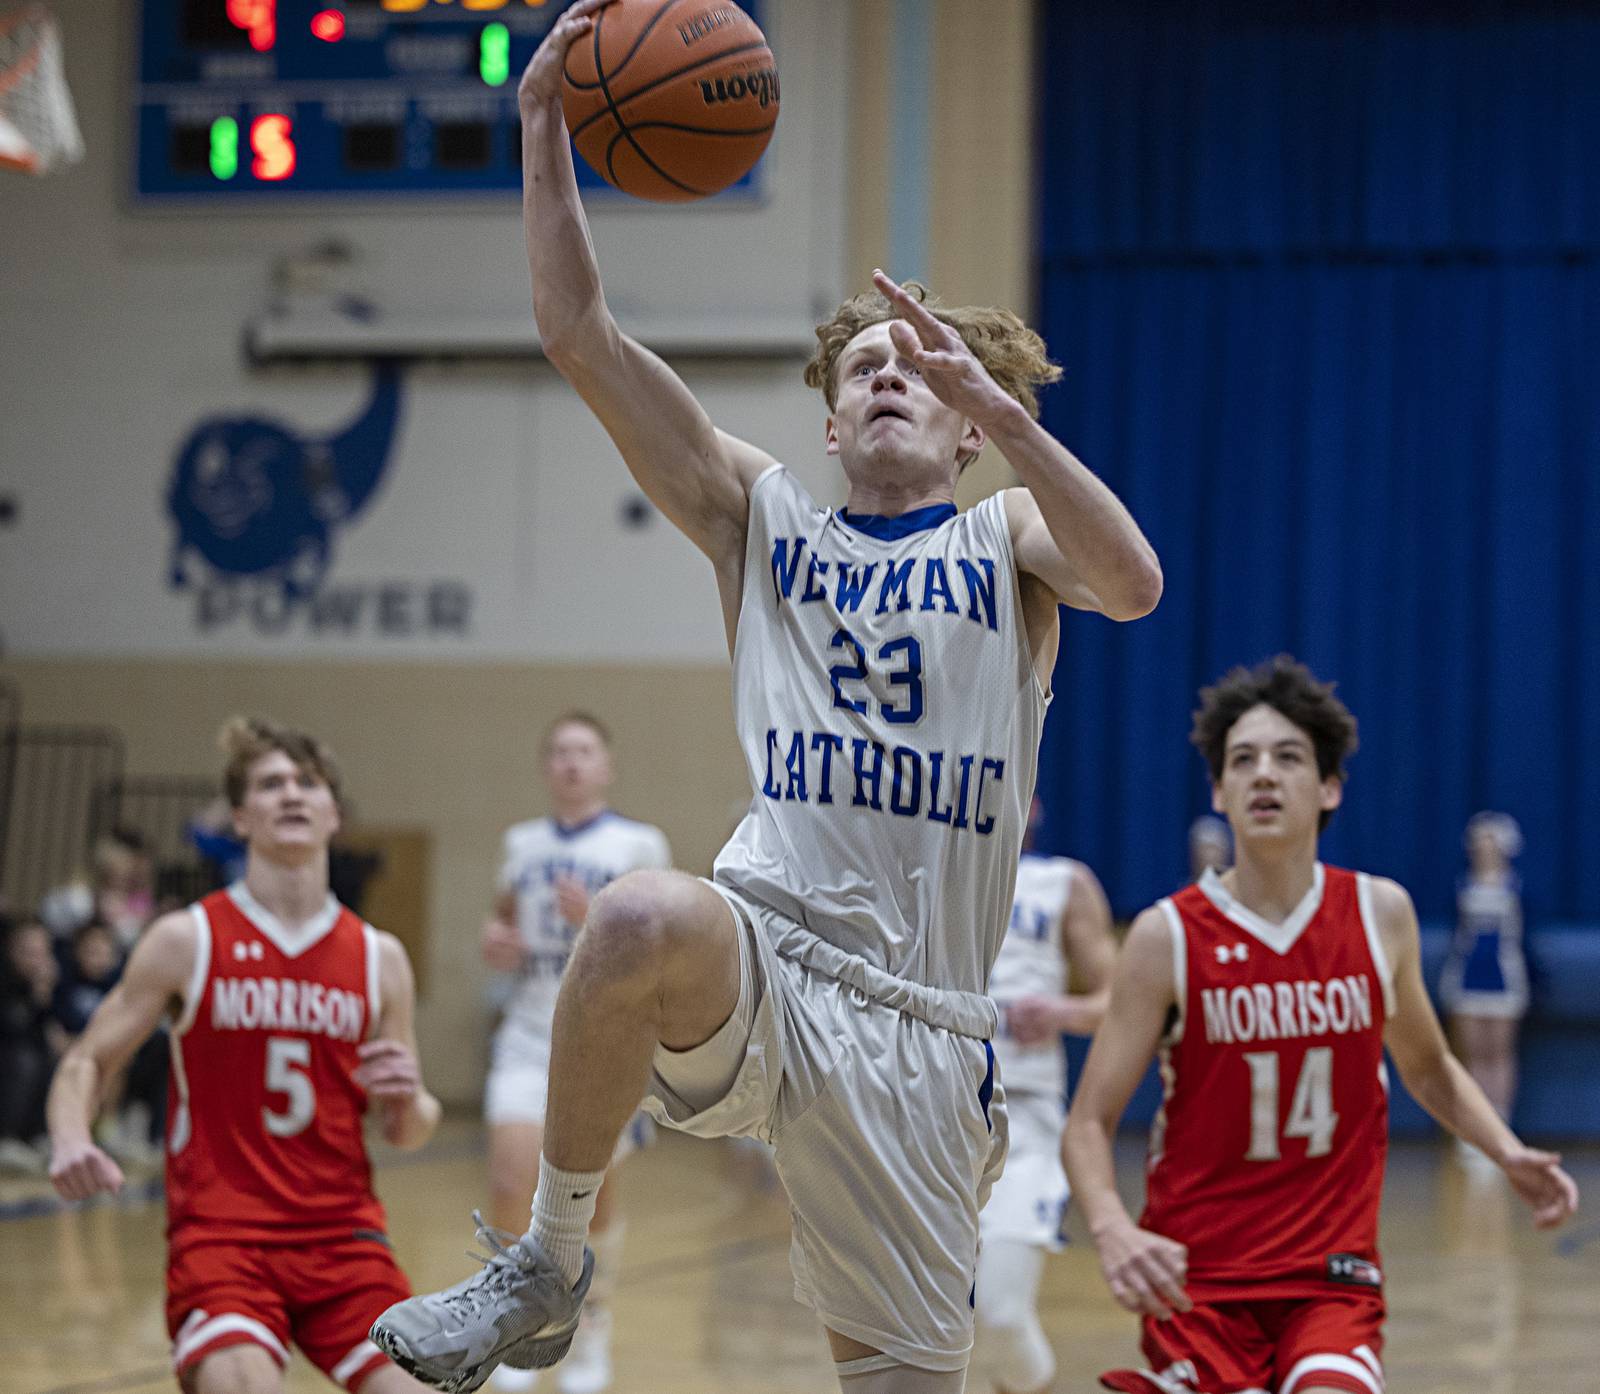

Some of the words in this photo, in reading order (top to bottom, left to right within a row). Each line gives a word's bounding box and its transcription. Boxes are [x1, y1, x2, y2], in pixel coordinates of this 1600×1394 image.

[772, 537, 998, 632] NEWMAN
[828, 627, 924, 725] 23
[763, 729, 1004, 835] CATHOLIC
[212, 976, 364, 1042] MORRISON
[1201, 974, 1372, 1044] MORRISON
[261, 1037, 315, 1137] 5
[1242, 1046, 1339, 1161] 14
